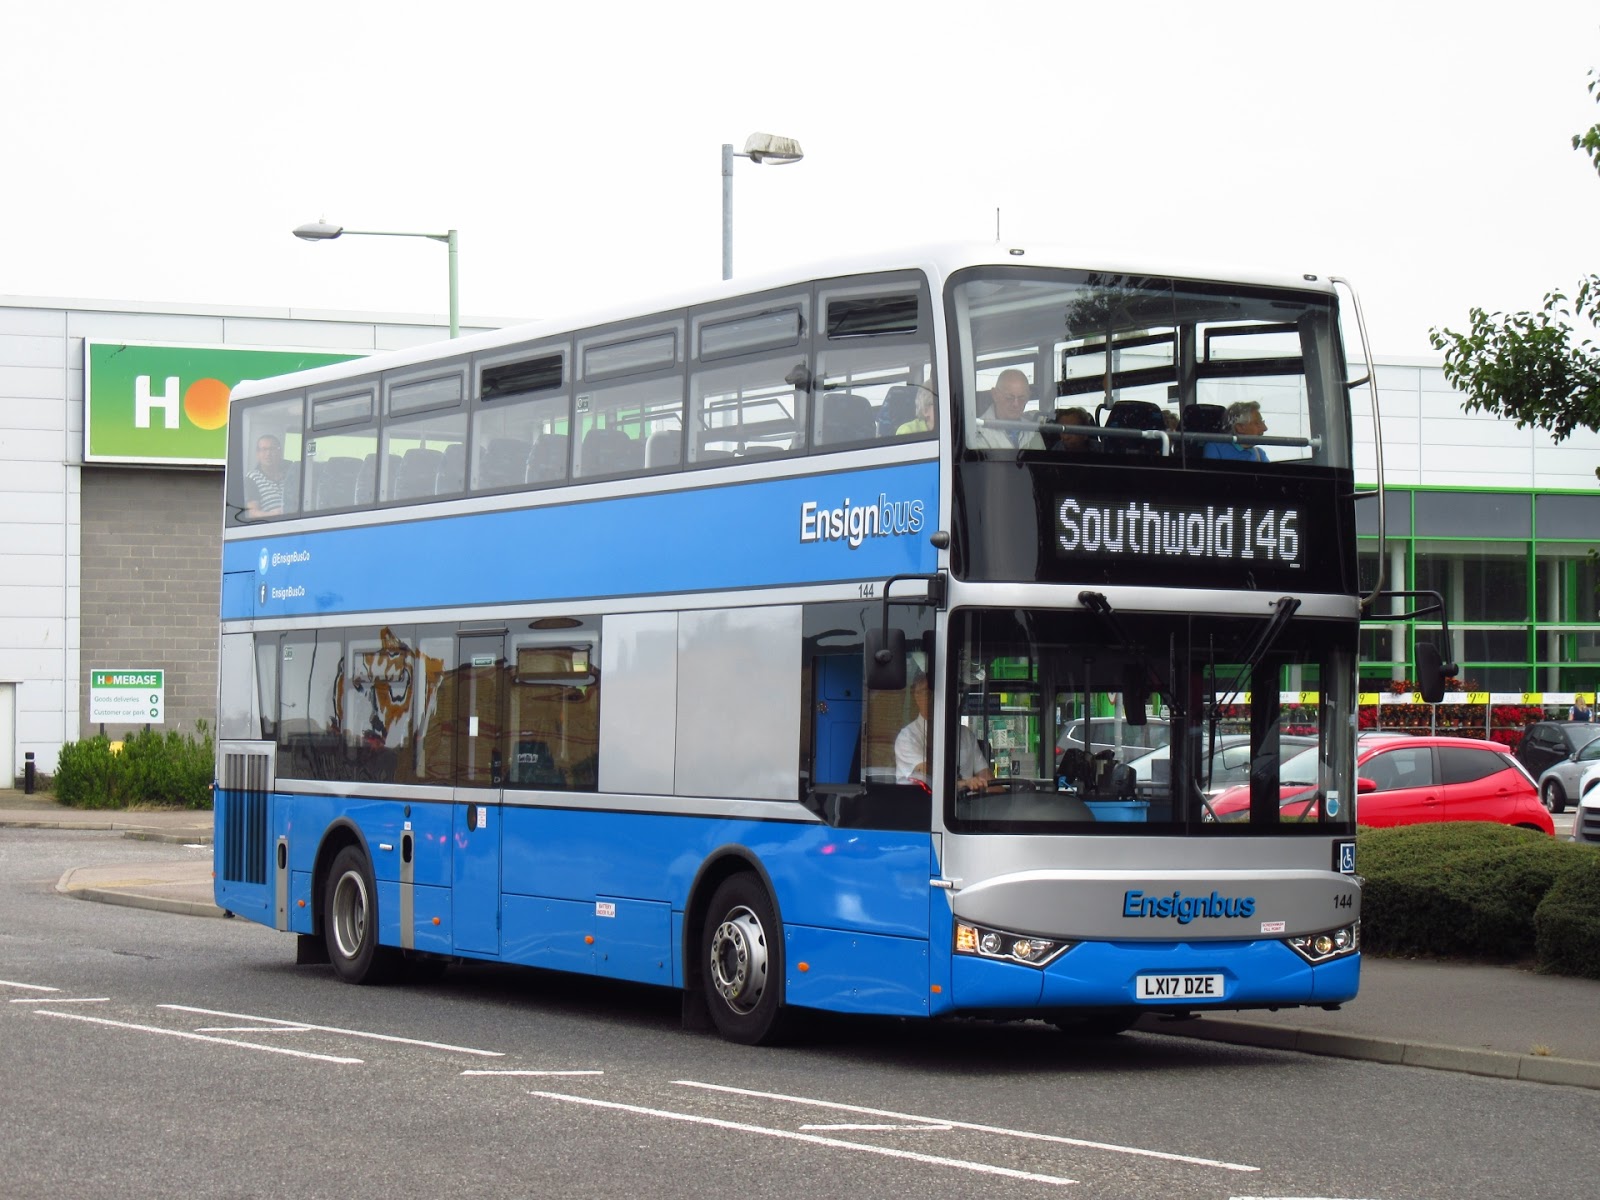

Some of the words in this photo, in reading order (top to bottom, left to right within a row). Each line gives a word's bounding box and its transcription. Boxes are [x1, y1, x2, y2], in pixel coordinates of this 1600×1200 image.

[800, 492, 925, 551] Ensignbus
[1059, 498, 1234, 558] Southwold
[1241, 508, 1299, 561] 146
[271, 550, 311, 567] @EnsignBusCo
[271, 585, 306, 601] EnsignBusCo
[858, 583, 875, 599] 144
[97, 675, 157, 685] HOMEBASE
[133, 709, 145, 717] park
[1123, 890, 1256, 924] Ensignbus
[1333, 894, 1353, 909] 144
[1144, 978, 1180, 996] LX17
[1184, 977, 1214, 995] DZE
